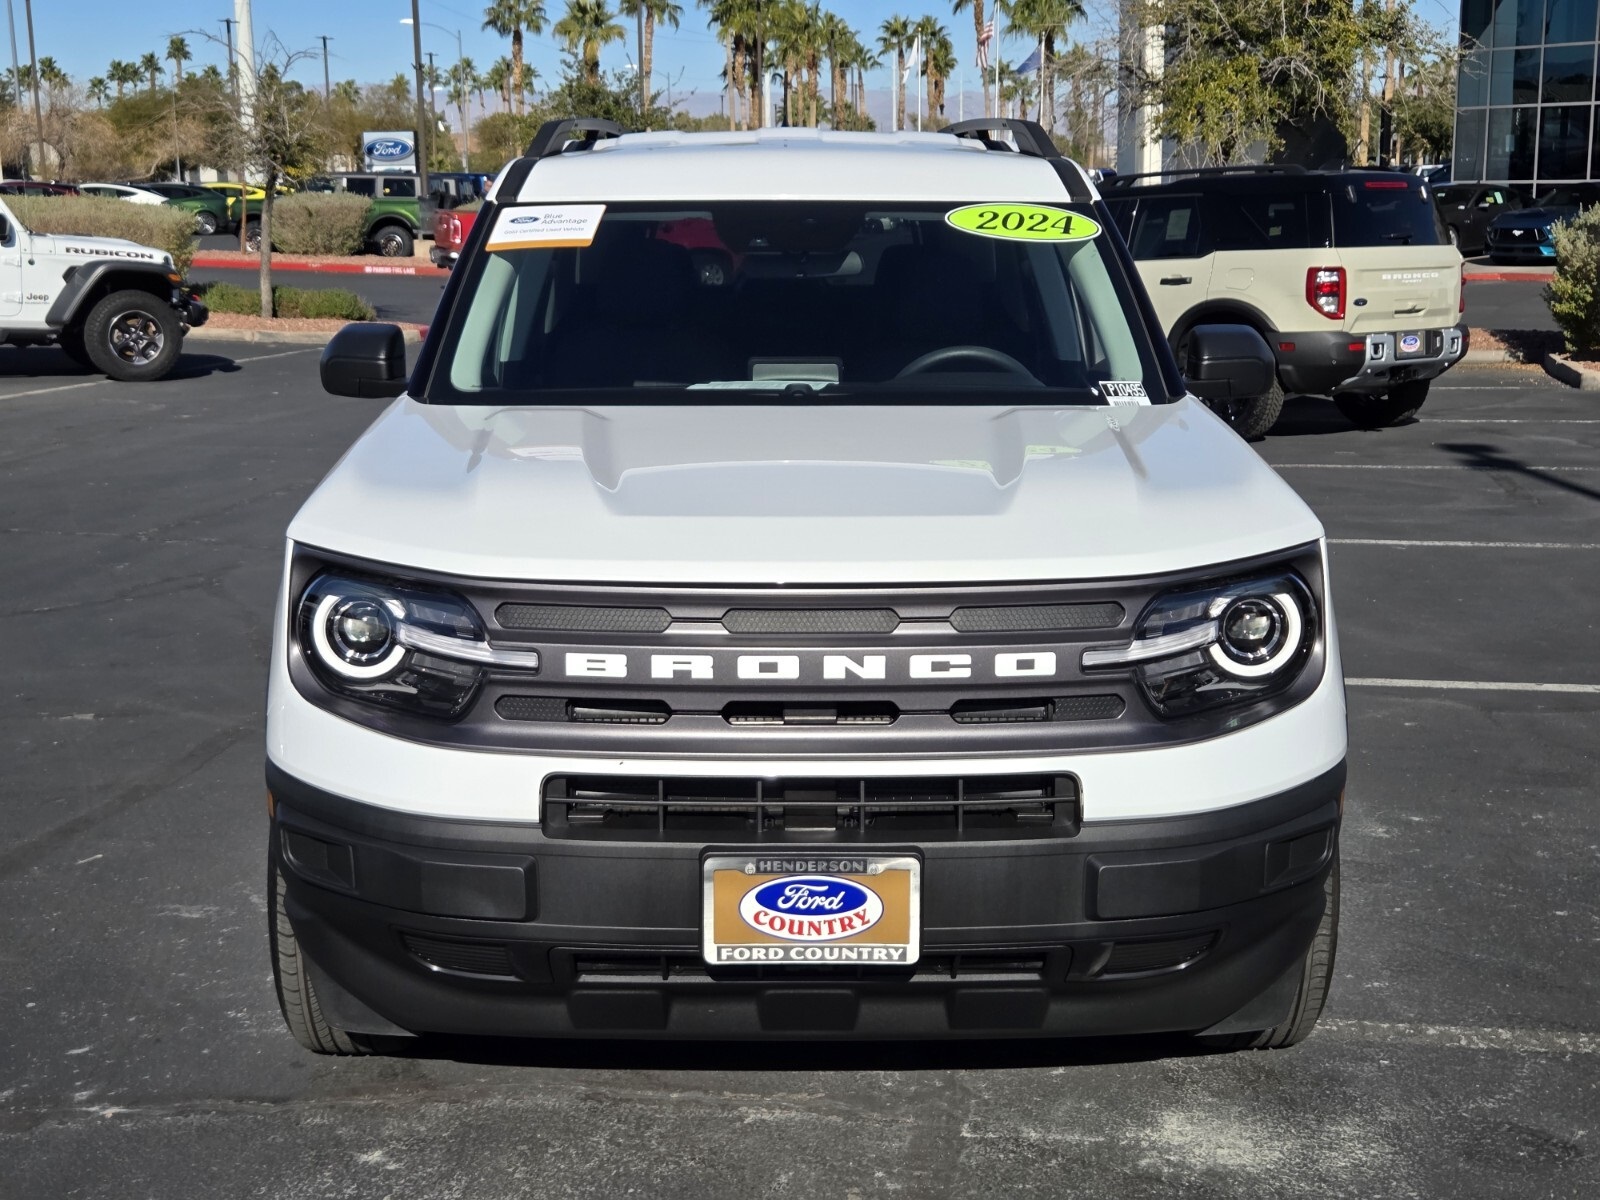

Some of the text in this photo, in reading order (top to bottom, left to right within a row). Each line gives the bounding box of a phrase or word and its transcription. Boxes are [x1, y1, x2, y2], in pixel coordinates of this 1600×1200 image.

[374, 141, 402, 155] Ford
[976, 210, 1076, 235] 2024
[65, 246, 154, 260] RUBICON
[1382, 272, 1439, 280] BRONCO
[26, 292, 50, 301] Jeep
[1107, 383, 1145, 396] P10495
[565, 651, 1057, 680] BRONCO
[759, 860, 864, 872] HENDERSON
[777, 884, 845, 910] Ford
[753, 908, 871, 936] COUNTRY
[720, 948, 904, 960] FORD COUNTRY
